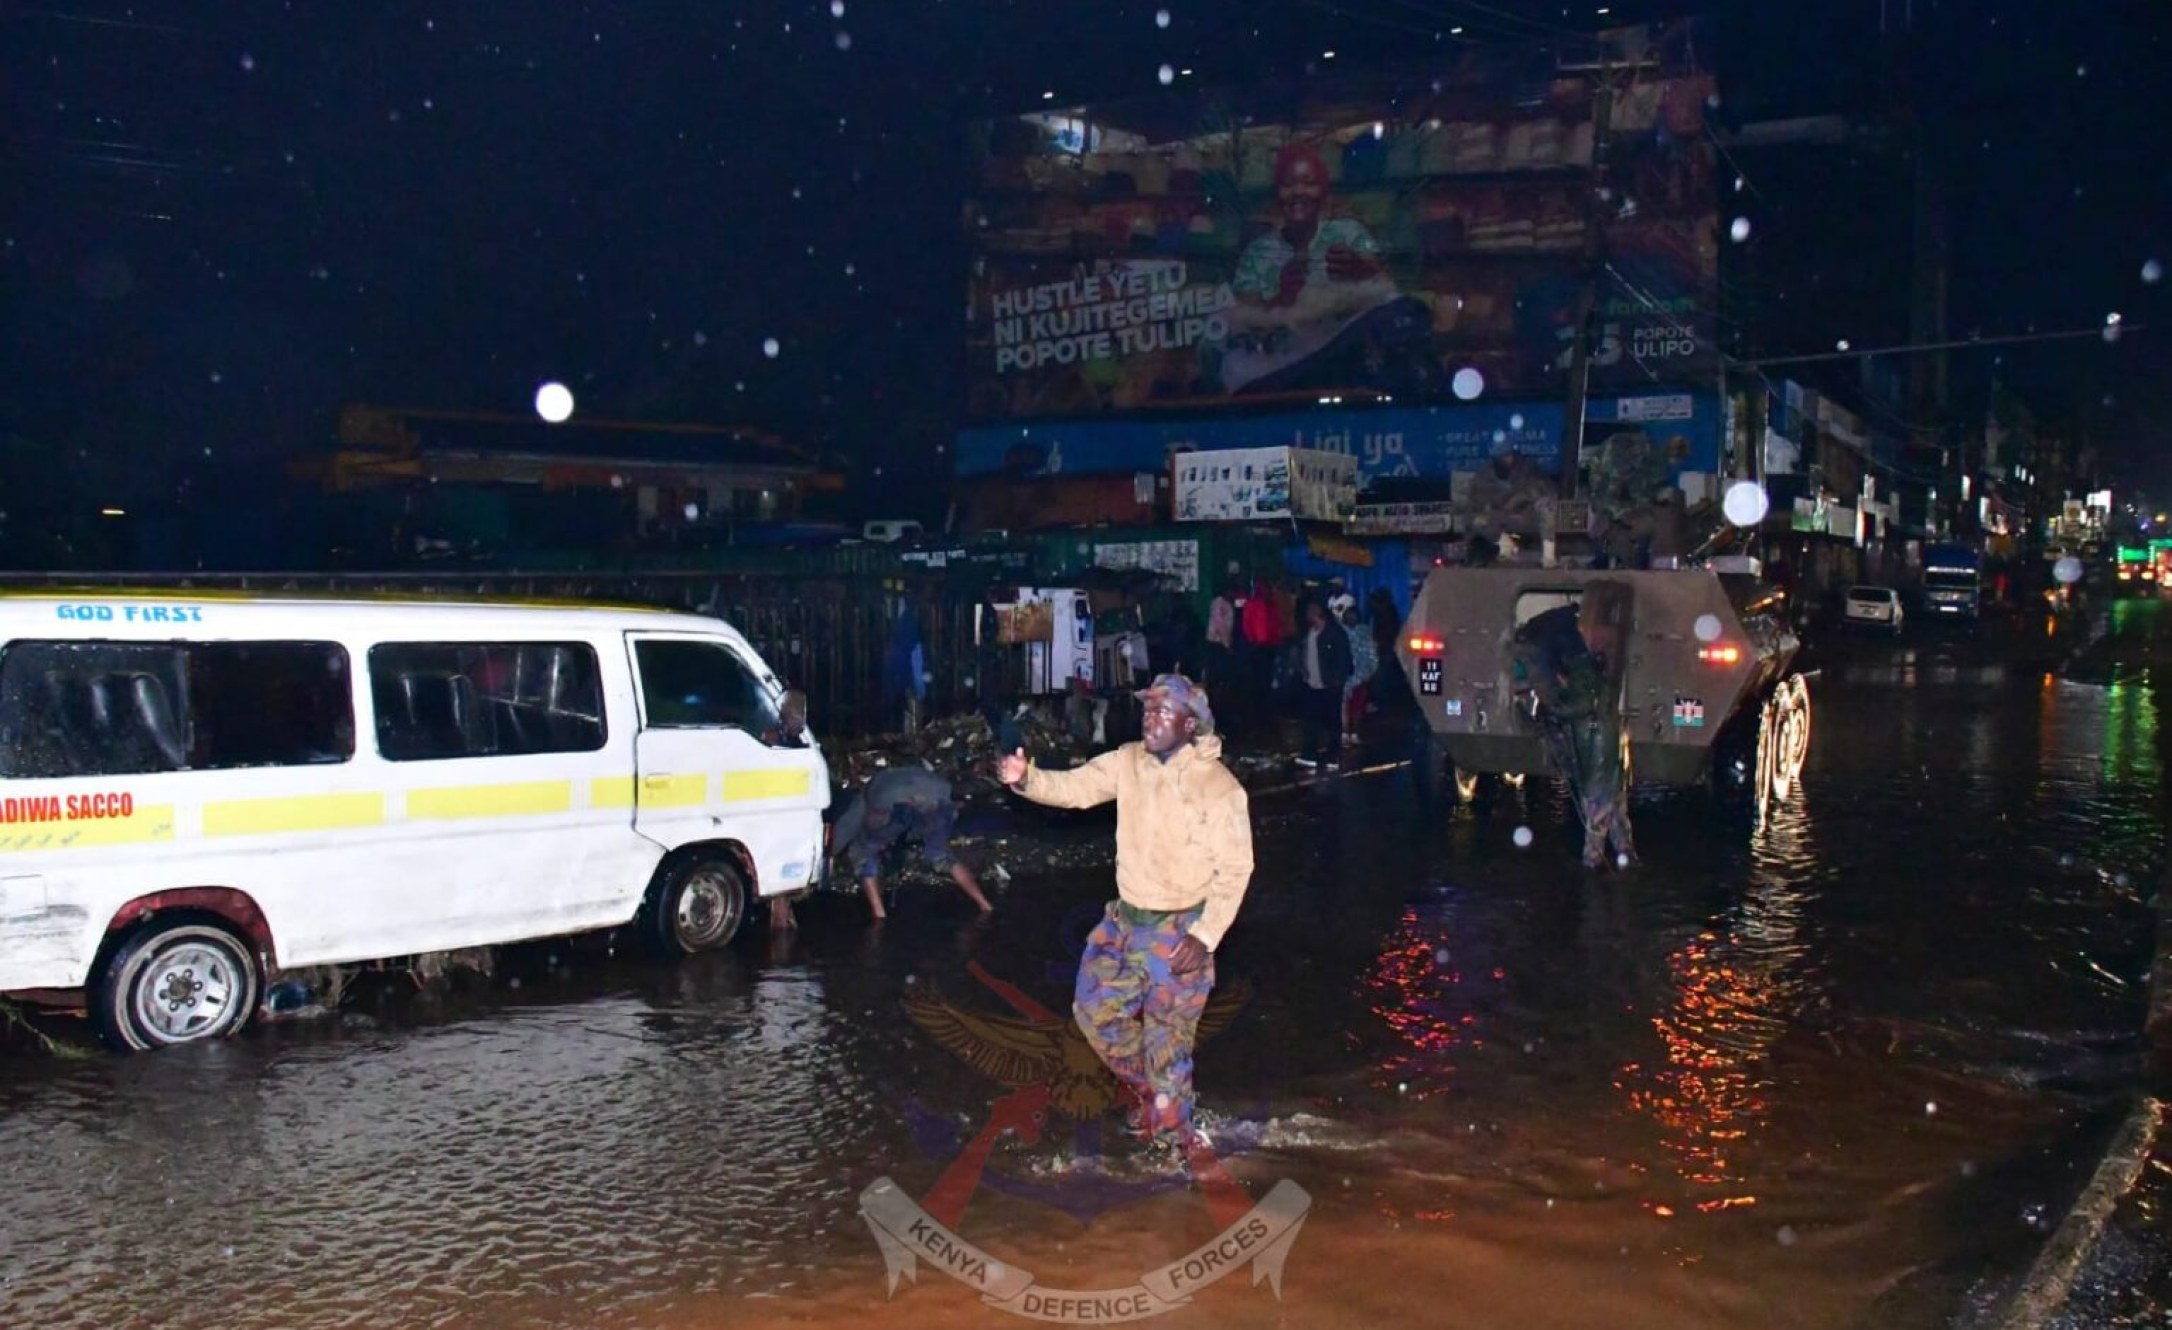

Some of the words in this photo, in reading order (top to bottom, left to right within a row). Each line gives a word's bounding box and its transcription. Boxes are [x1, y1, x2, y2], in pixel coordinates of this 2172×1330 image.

[993, 276, 1101, 319] HUSTLE
[1107, 262, 1187, 299] YETU
[994, 318, 1025, 345] NI
[1030, 282, 1236, 339] KUJITEGEMEA
[996, 331, 1112, 373] POPOTE
[1115, 313, 1230, 355] TULIPO
[1632, 325, 1695, 341] POPOTE
[1363, 432, 1404, 465] ya
[56, 604, 113, 621] GOD
[123, 606, 203, 623] FIRST
[0, 795, 61, 823] DIWA
[66, 792, 133, 819] SACCO
